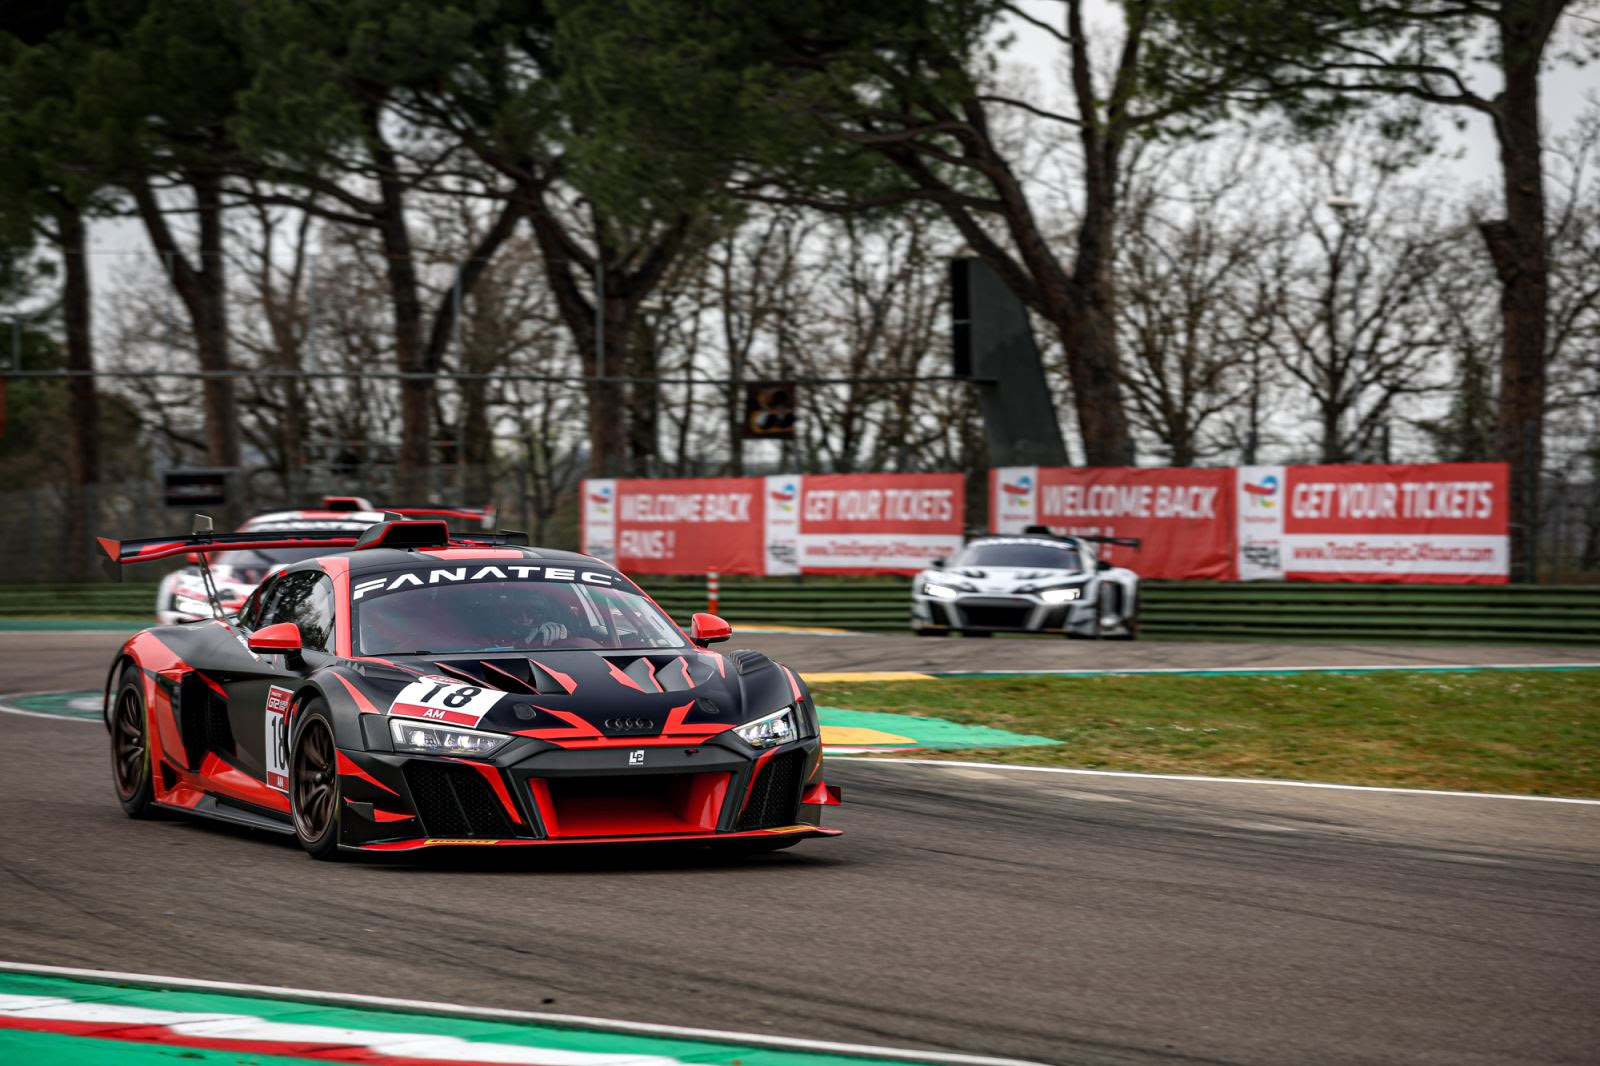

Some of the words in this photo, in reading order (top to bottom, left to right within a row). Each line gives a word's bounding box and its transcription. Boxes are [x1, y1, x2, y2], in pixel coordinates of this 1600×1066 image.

[620, 494, 703, 523] WELCOME
[704, 493, 752, 523] BACK
[805, 489, 835, 521] GET
[836, 489, 881, 521] YOUR
[884, 489, 953, 521] TICKETS
[1041, 484, 1154, 518] WELCOME
[1155, 486, 1218, 519] BACK
[1292, 483, 1336, 519] GET
[1338, 483, 1398, 519] YOUR
[1402, 481, 1494, 519] TICKETS
[353, 566, 613, 600] FANATEC
[420, 682, 482, 708] 18
[423, 709, 446, 719] AM
[271, 715, 286, 770] 18
